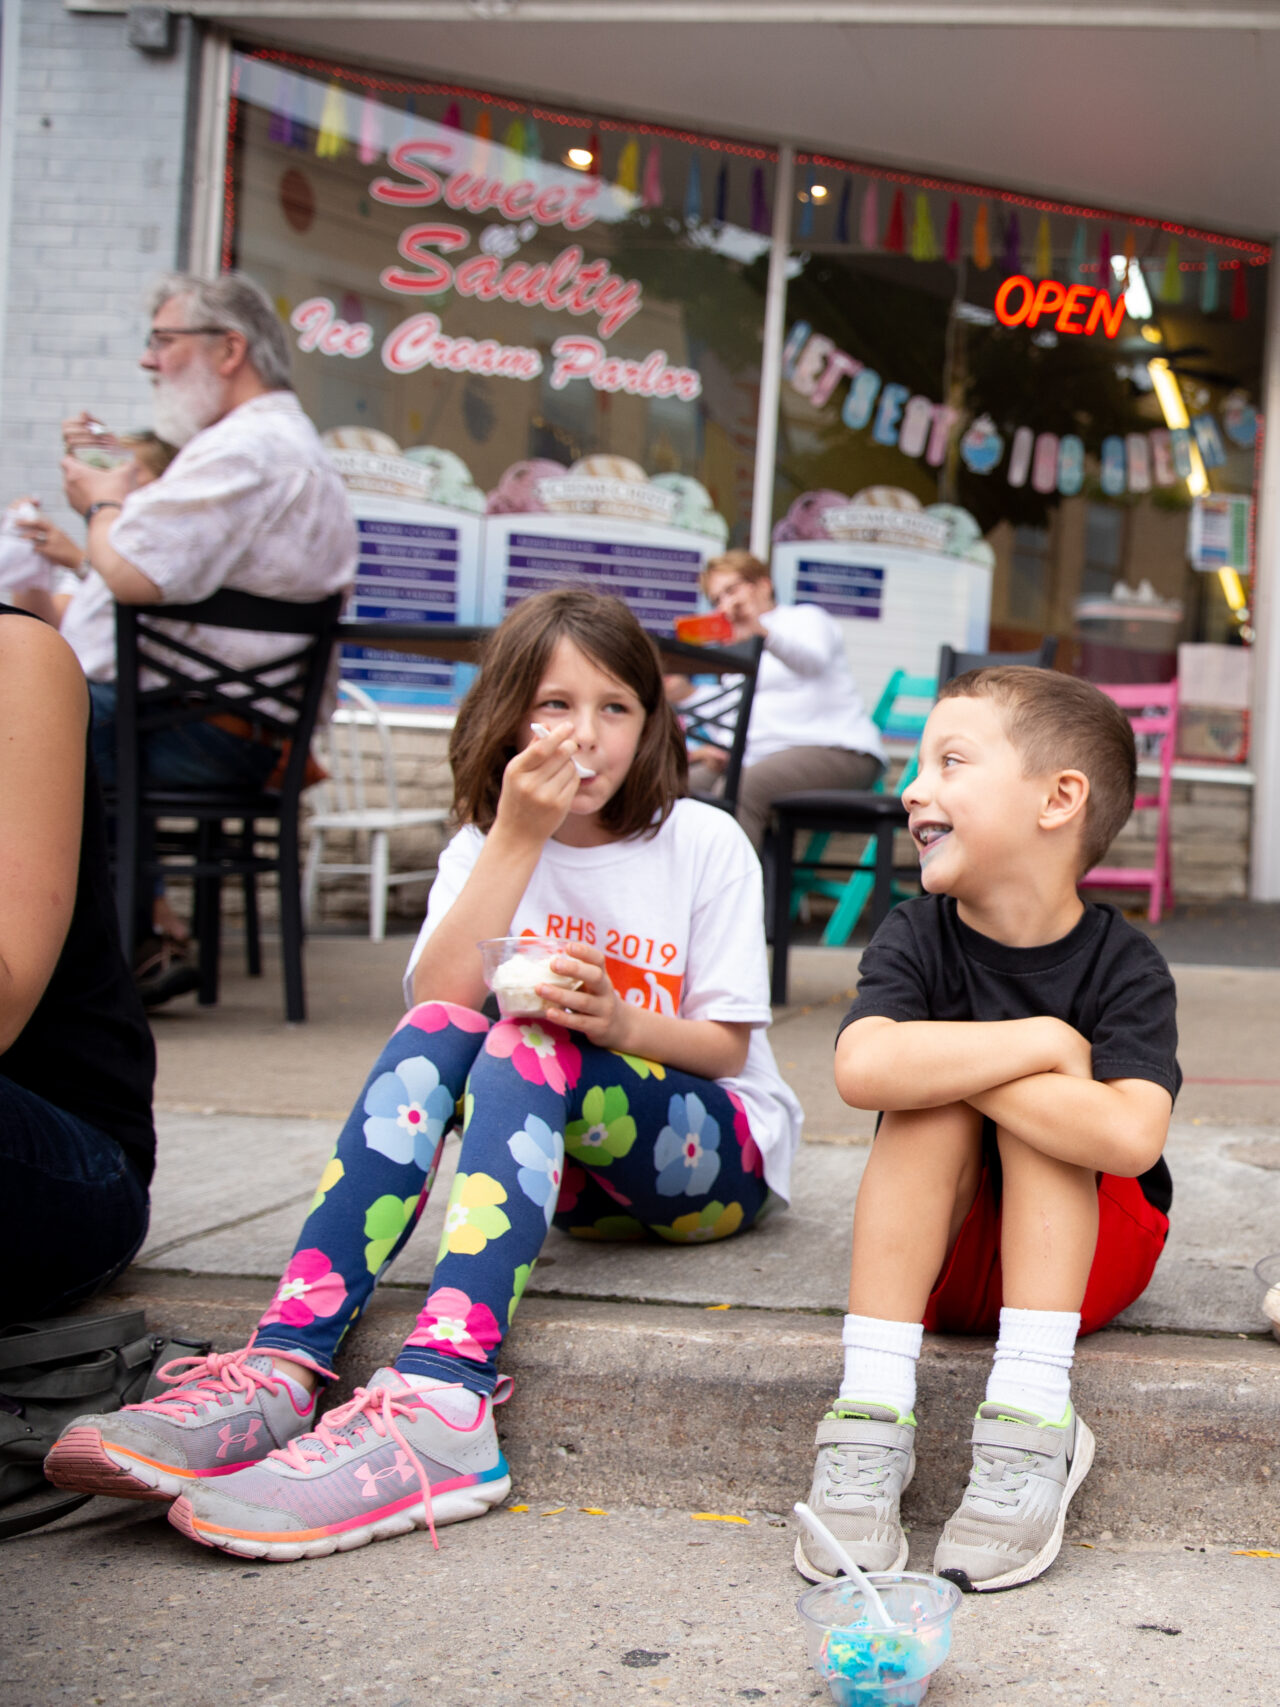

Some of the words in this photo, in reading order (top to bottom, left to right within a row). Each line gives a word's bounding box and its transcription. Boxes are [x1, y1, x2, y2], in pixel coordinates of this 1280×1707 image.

[370, 138, 602, 231] Sweet
[379, 222, 643, 339] Saulty
[994, 274, 1127, 339] OPEN
[291, 297, 374, 359] Ice
[381, 312, 543, 375] Cream
[551, 334, 703, 401] Parlor
[546, 913, 597, 946] RHS
[604, 928, 678, 968] 2019
